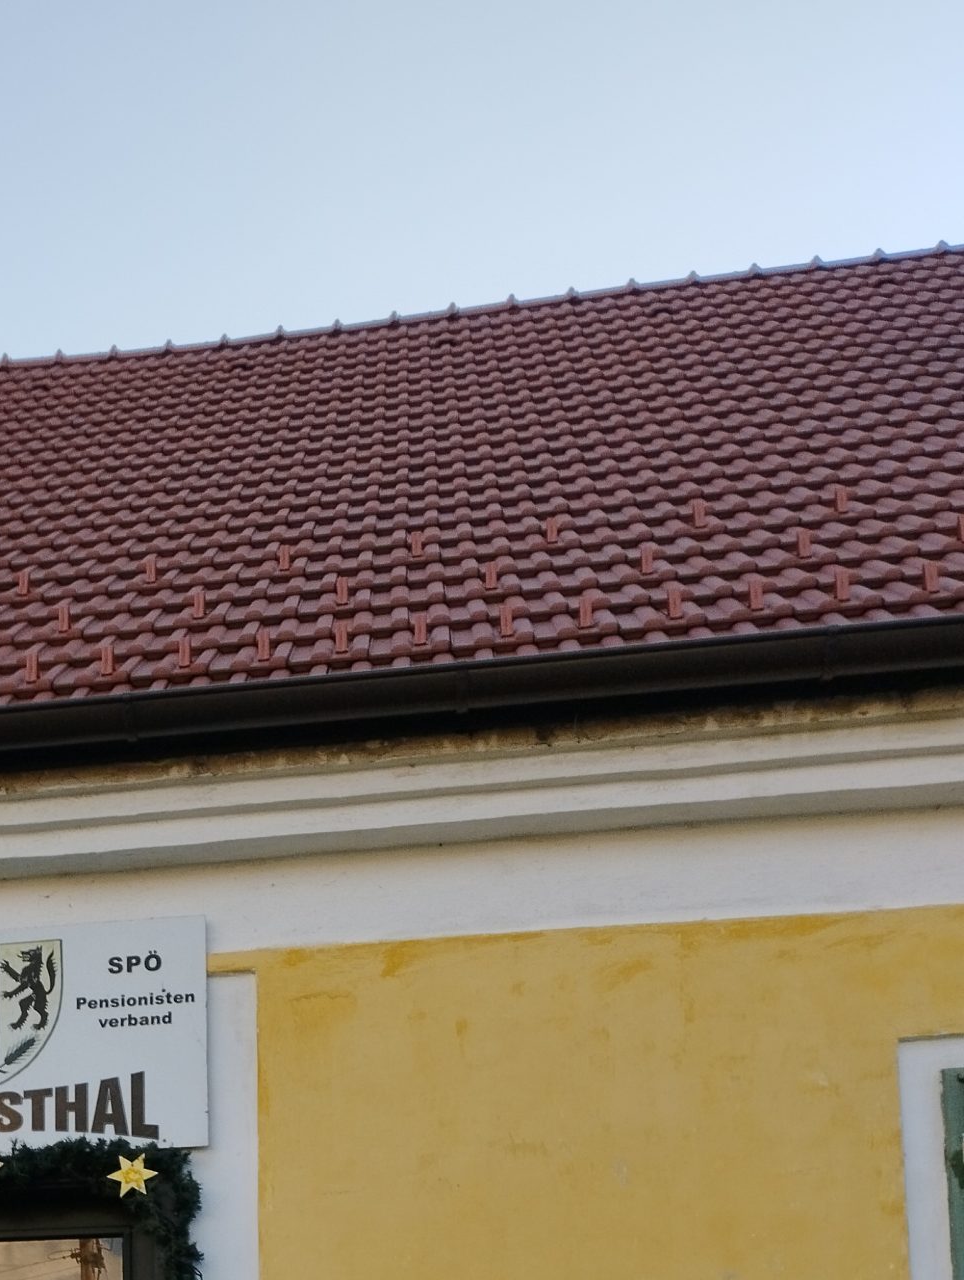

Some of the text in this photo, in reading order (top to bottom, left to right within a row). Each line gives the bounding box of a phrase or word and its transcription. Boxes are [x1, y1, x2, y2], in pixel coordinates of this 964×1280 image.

[107, 949, 163, 975] SPÖ
[75, 992, 196, 1010] Pensionisten
[98, 1011, 173, 1029] verband
